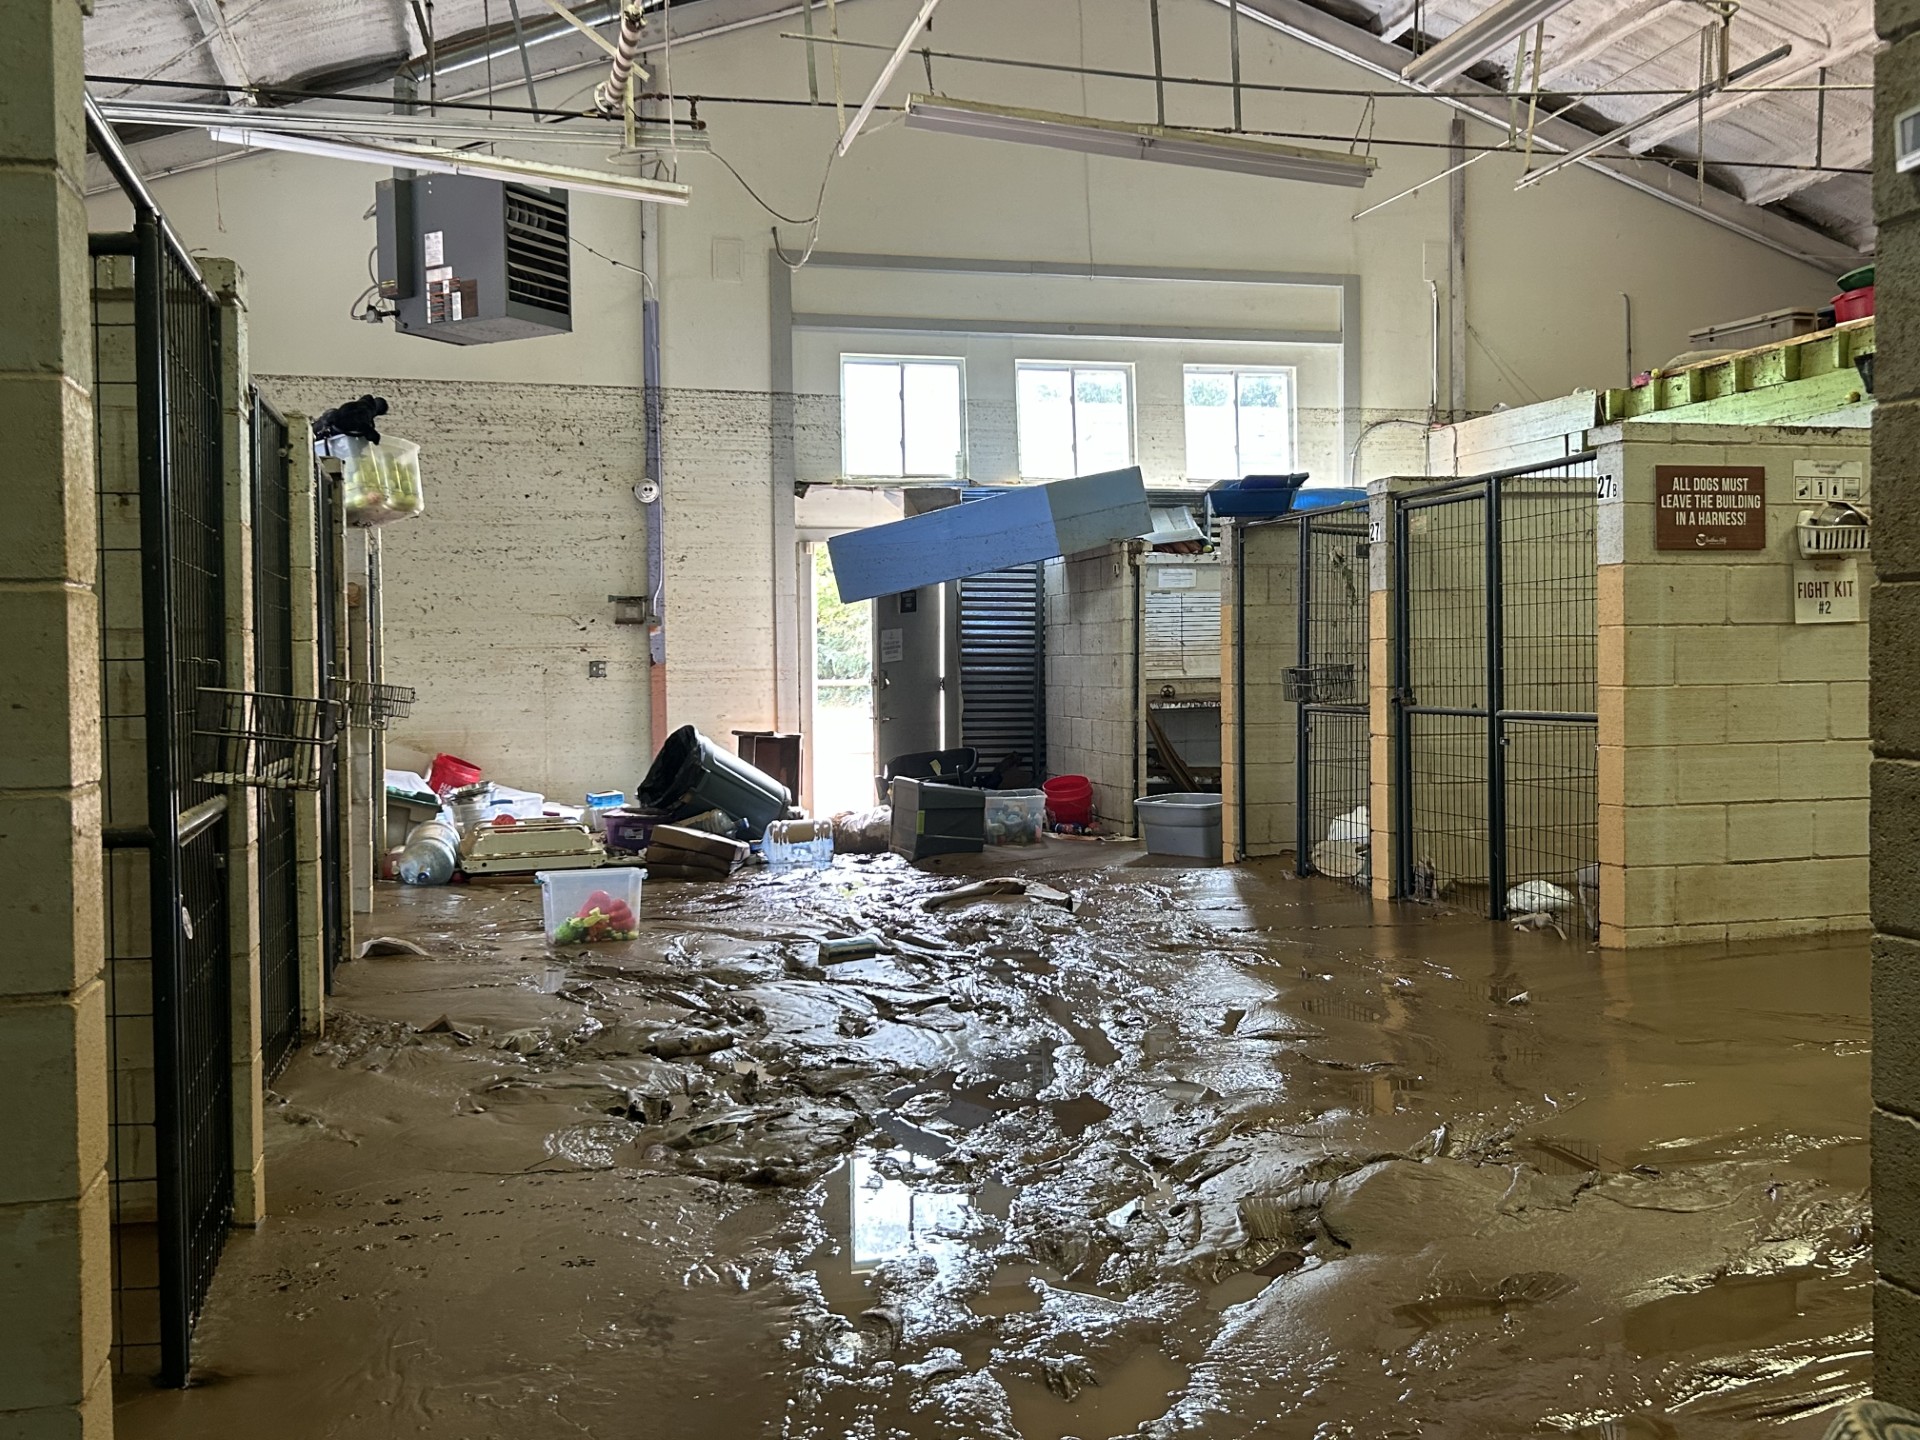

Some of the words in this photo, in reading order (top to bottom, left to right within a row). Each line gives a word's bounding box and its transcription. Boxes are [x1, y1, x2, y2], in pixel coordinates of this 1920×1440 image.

[1672, 477, 1691, 491] ALL
[1693, 477, 1719, 492] DOGS
[1721, 477, 1749, 492] MUST
[1661, 494, 1692, 508] LEAVE
[1694, 494, 1714, 508] THE
[1716, 494, 1761, 509] BUILDING
[1675, 511, 1686, 526] IN
[1688, 511, 1696, 526] A
[1698, 511, 1747, 526] HARNESS!
[1369, 522, 1380, 542] 27
[1797, 581, 1830, 599] FIGHT
[1834, 580, 1854, 598] KIT
[1818, 600, 1832, 615] #2
